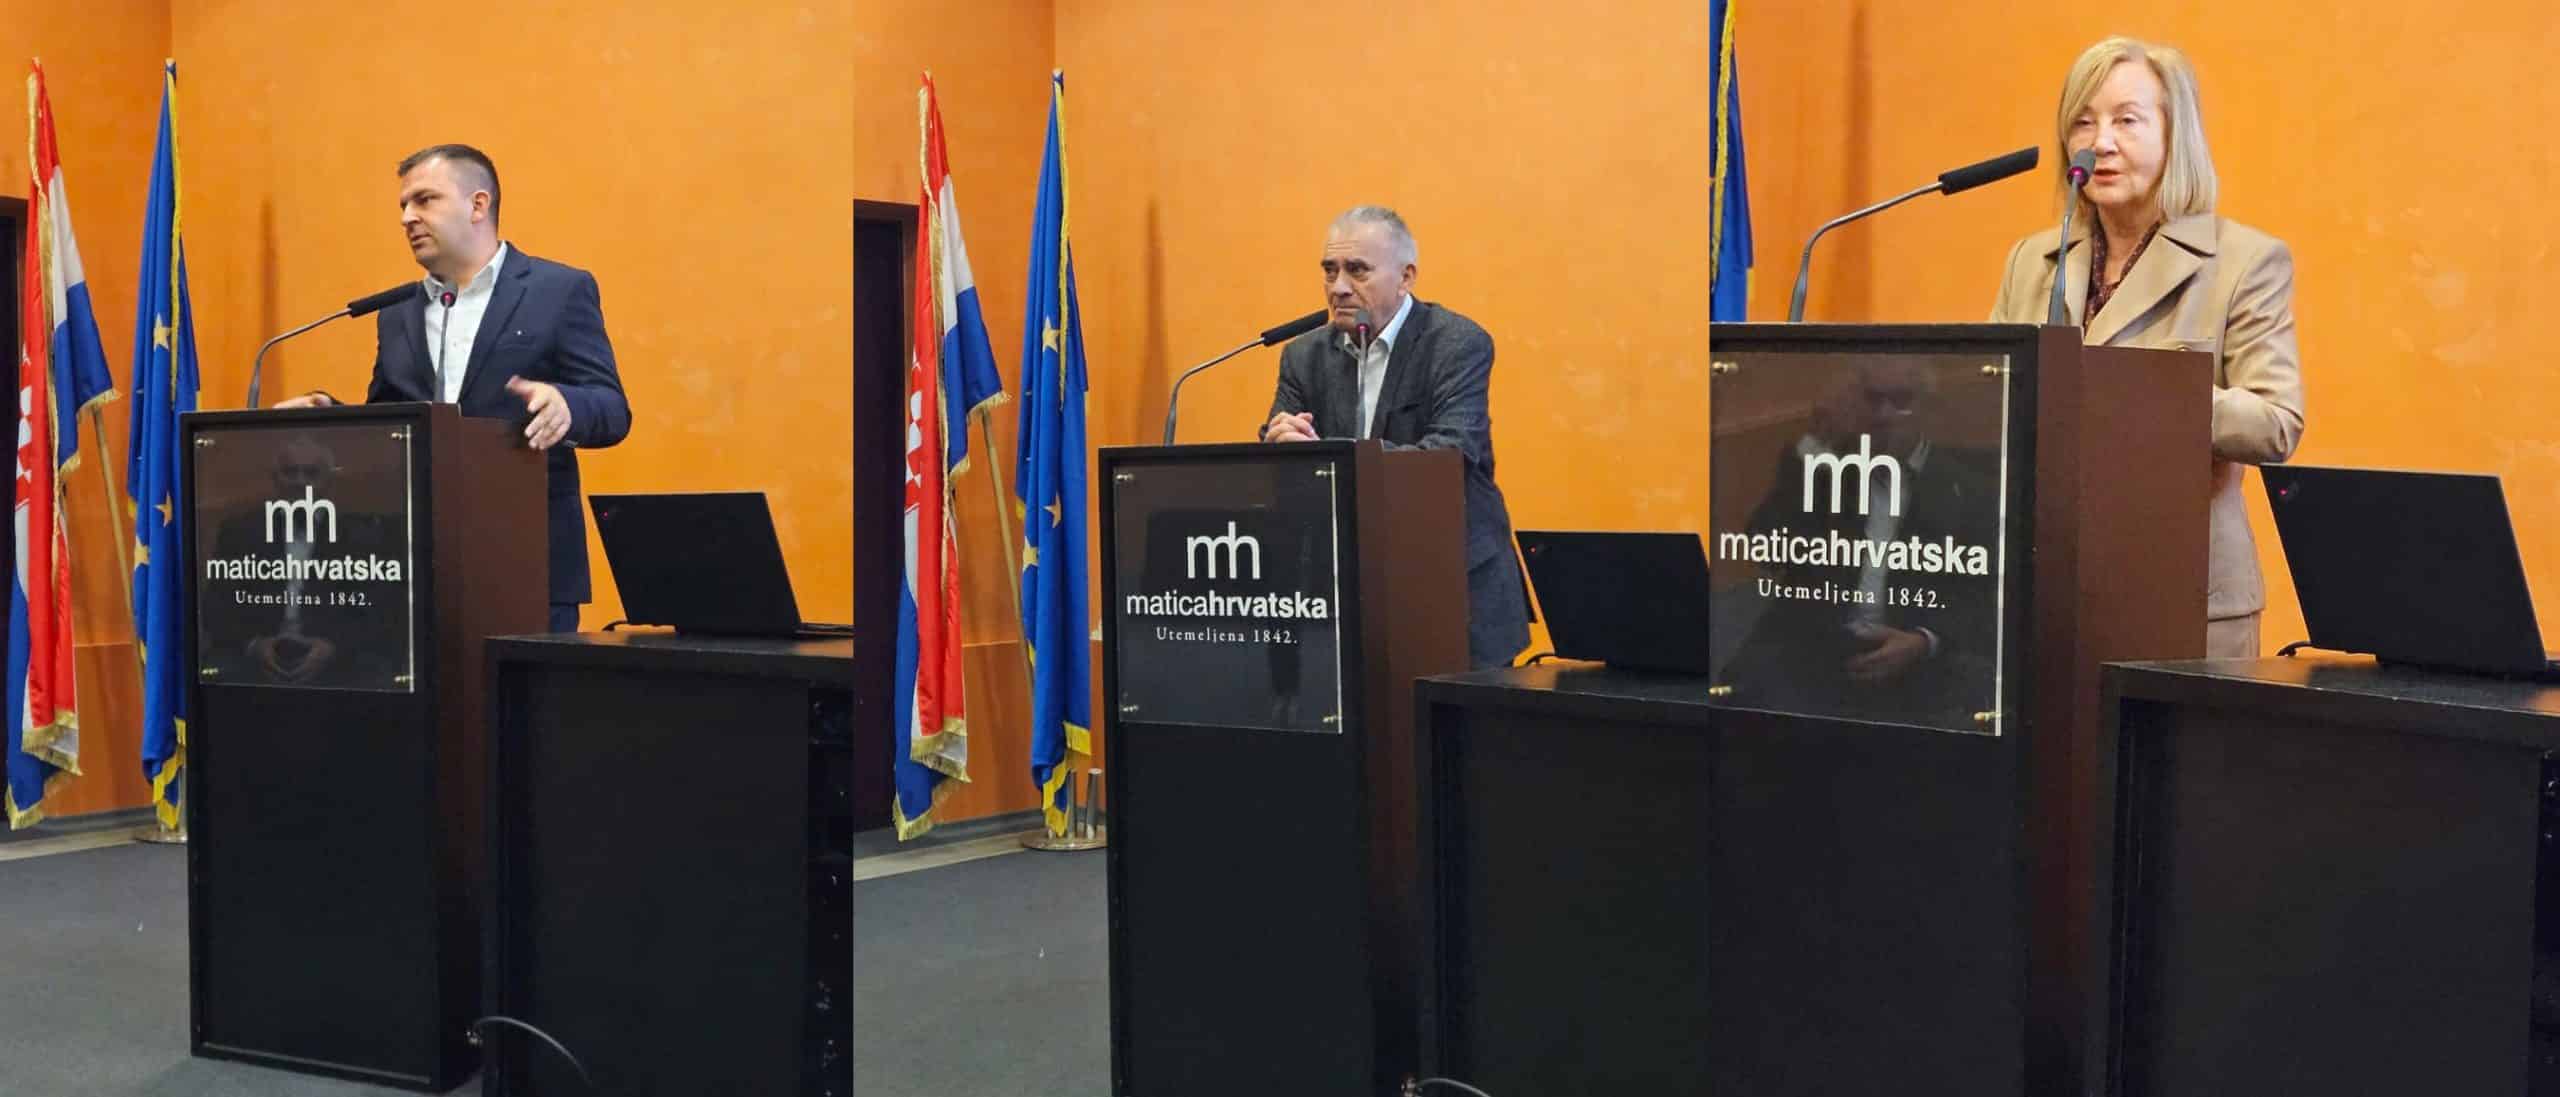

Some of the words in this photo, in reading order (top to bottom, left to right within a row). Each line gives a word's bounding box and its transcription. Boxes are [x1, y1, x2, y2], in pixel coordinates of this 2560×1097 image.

[1719, 527, 1989, 576] maticahrvatska
[206, 554, 401, 581] maticahrvatska
[235, 591, 321, 607] Utemeljena
[329, 592, 372, 606] 1842.
[1126, 589, 1328, 619] maticahrvatska
[1758, 578, 1875, 606] Utemeljena
[1887, 588, 1946, 609] 1842.
[1156, 627, 1245, 643] Utemeljena
[1253, 630, 1298, 644] 1842.
